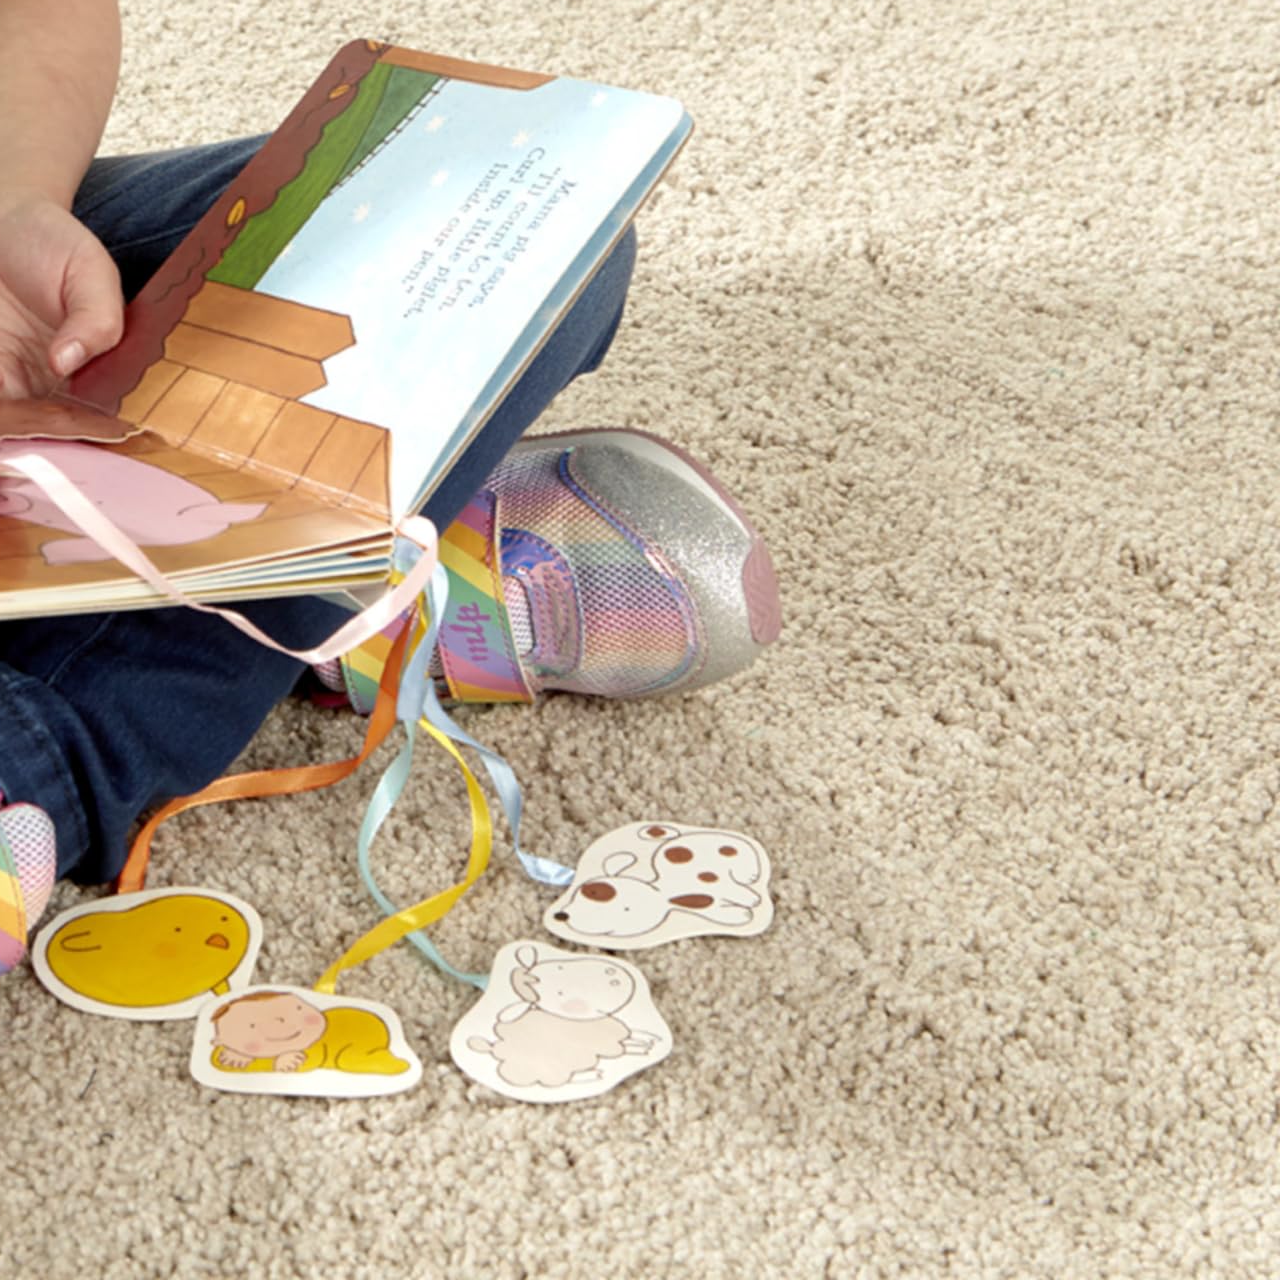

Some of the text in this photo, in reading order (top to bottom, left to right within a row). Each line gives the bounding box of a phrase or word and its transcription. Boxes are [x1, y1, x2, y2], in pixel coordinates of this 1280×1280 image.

[509, 146, 546, 184] Curl
[526, 179, 578, 230] Mama
[434, 217, 460, 247] our
[448, 218, 492, 262] little
[484, 201, 528, 250] count
[467, 255, 491, 273] to
[501, 235, 530, 262] pig
